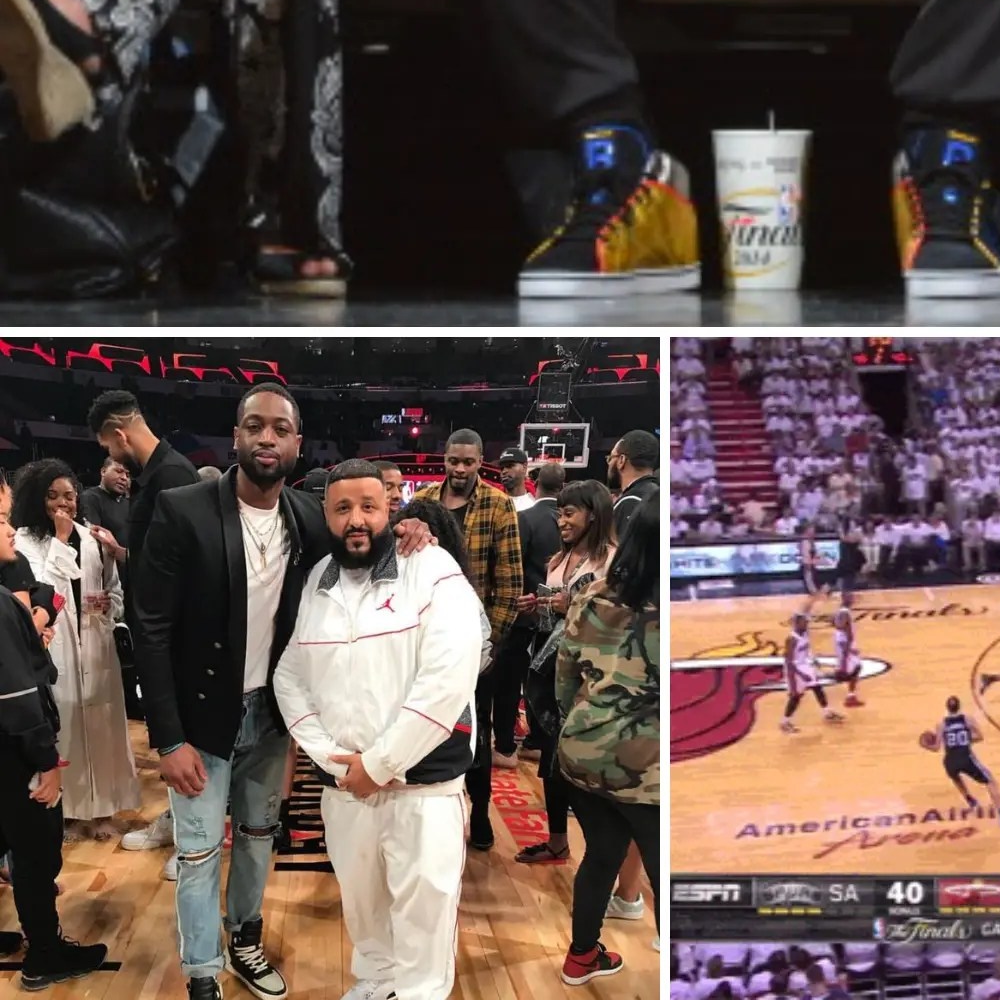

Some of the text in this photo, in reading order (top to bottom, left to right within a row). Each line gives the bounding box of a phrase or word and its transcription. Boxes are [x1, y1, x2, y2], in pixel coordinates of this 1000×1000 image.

[673, 884, 741, 902] ESPN
[828, 884, 860, 902] SA
[886, 881, 924, 904] 40
[902, 917, 972, 944] Finals
